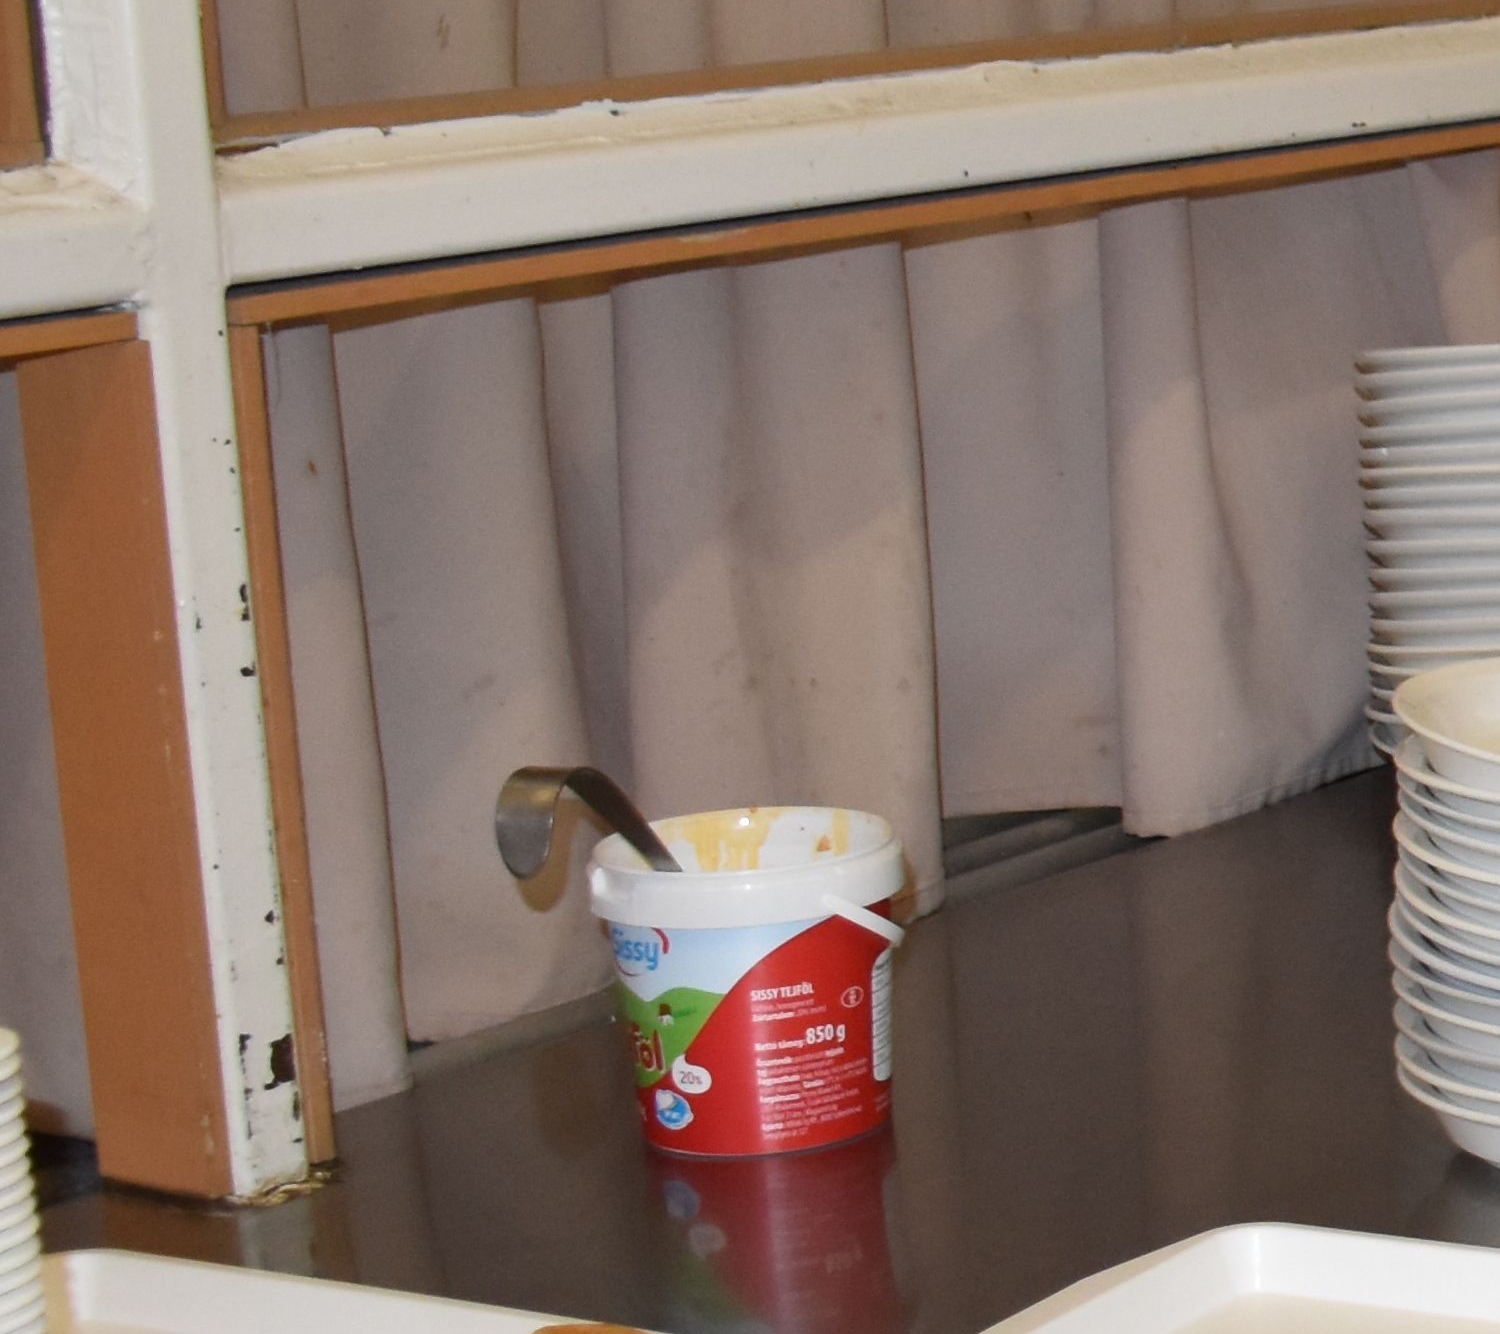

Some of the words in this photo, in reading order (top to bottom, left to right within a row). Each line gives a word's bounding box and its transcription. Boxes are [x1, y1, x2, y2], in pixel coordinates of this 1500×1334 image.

[751, 987, 779, 1002] SISSY
[806, 1024, 834, 1045] 850
[836, 1024, 846, 1042] g
